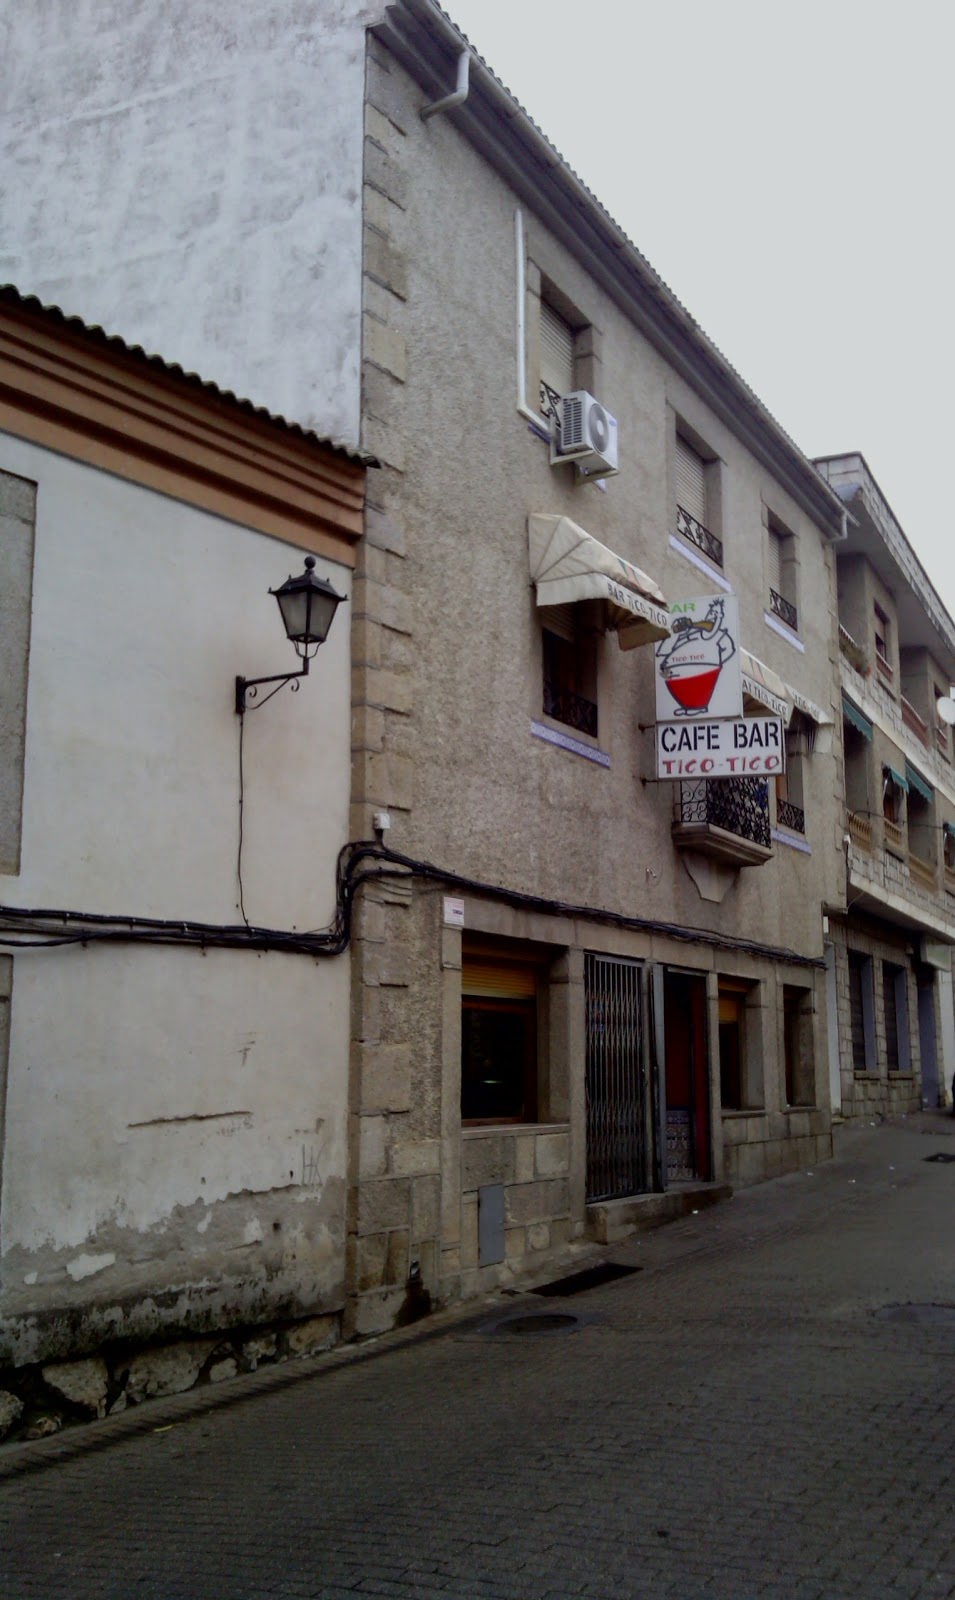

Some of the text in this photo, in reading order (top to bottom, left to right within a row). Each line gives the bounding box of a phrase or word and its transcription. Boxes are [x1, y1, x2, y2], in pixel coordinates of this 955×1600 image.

[607, 582, 625, 603] BAR
[669, 602, 696, 614] AR
[661, 721, 779, 753] CAFE BAR
